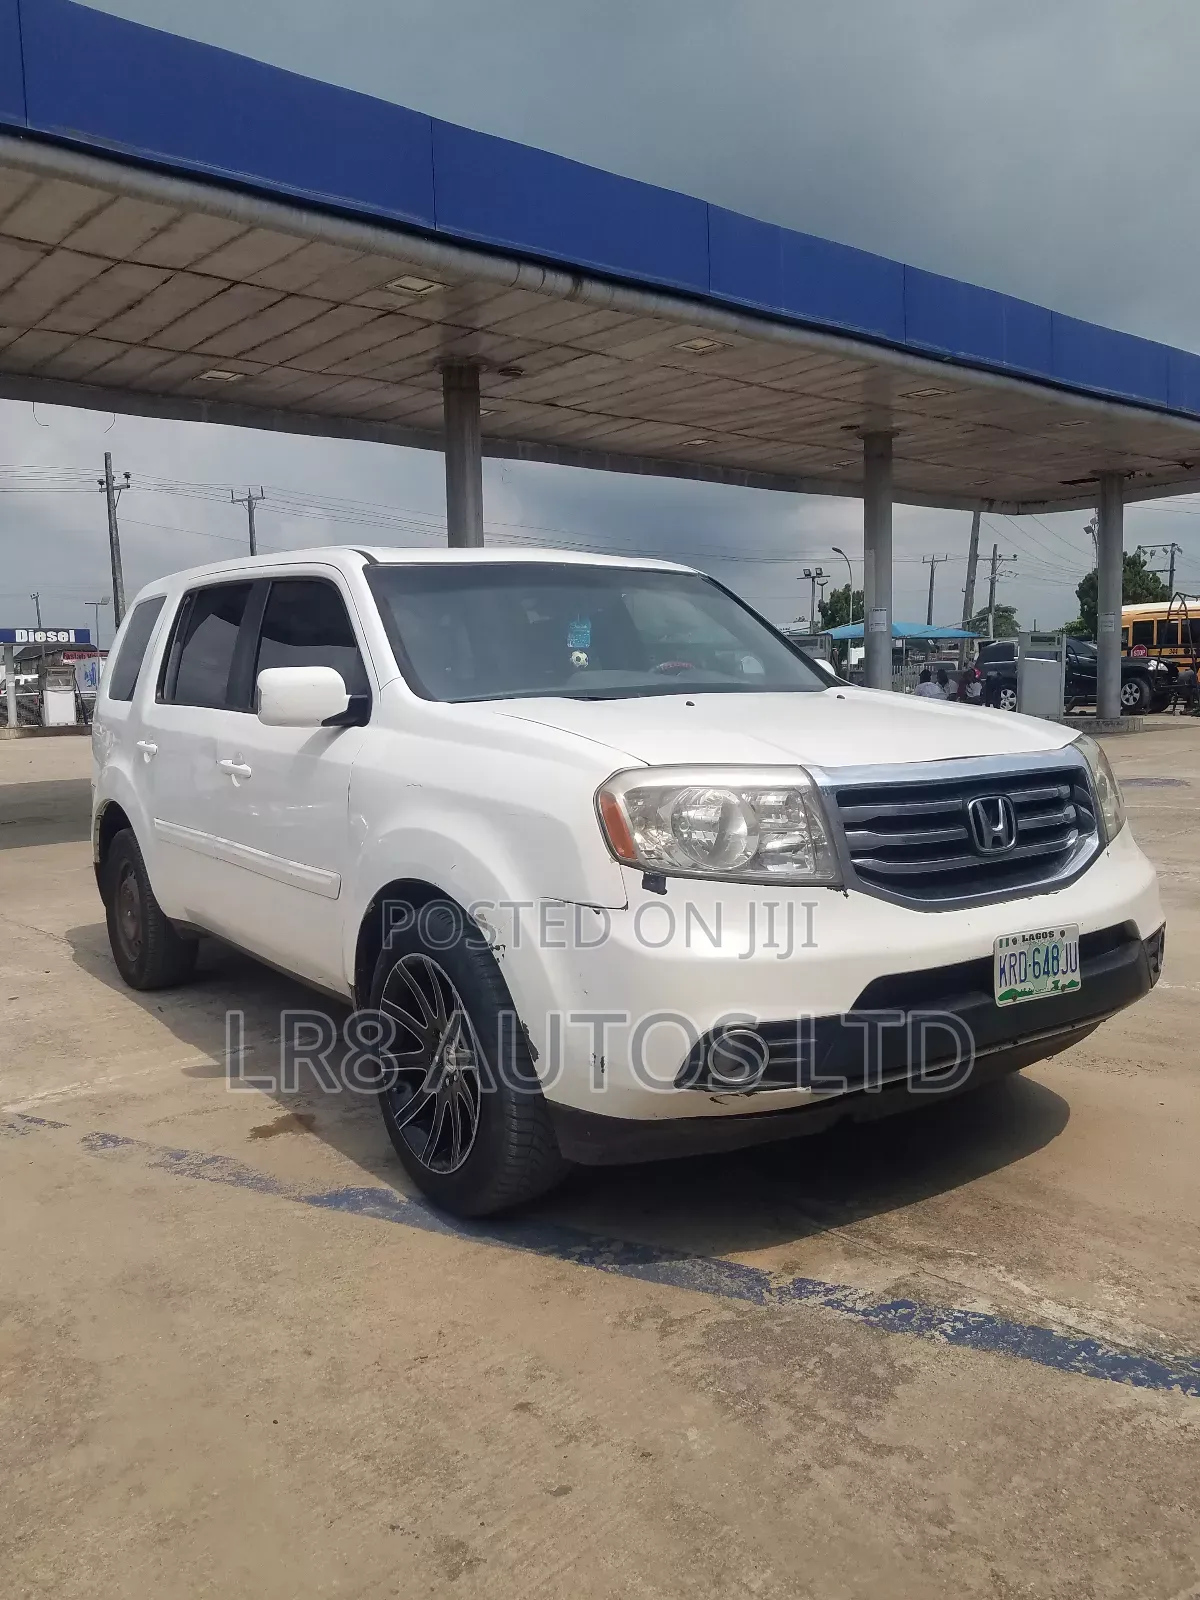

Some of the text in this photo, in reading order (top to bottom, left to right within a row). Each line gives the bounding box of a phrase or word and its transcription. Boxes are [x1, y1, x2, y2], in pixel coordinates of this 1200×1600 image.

[15, 629, 76, 643] Diesel
[1133, 649, 1146, 657] STOP
[1021, 930, 1055, 942] LAGOS
